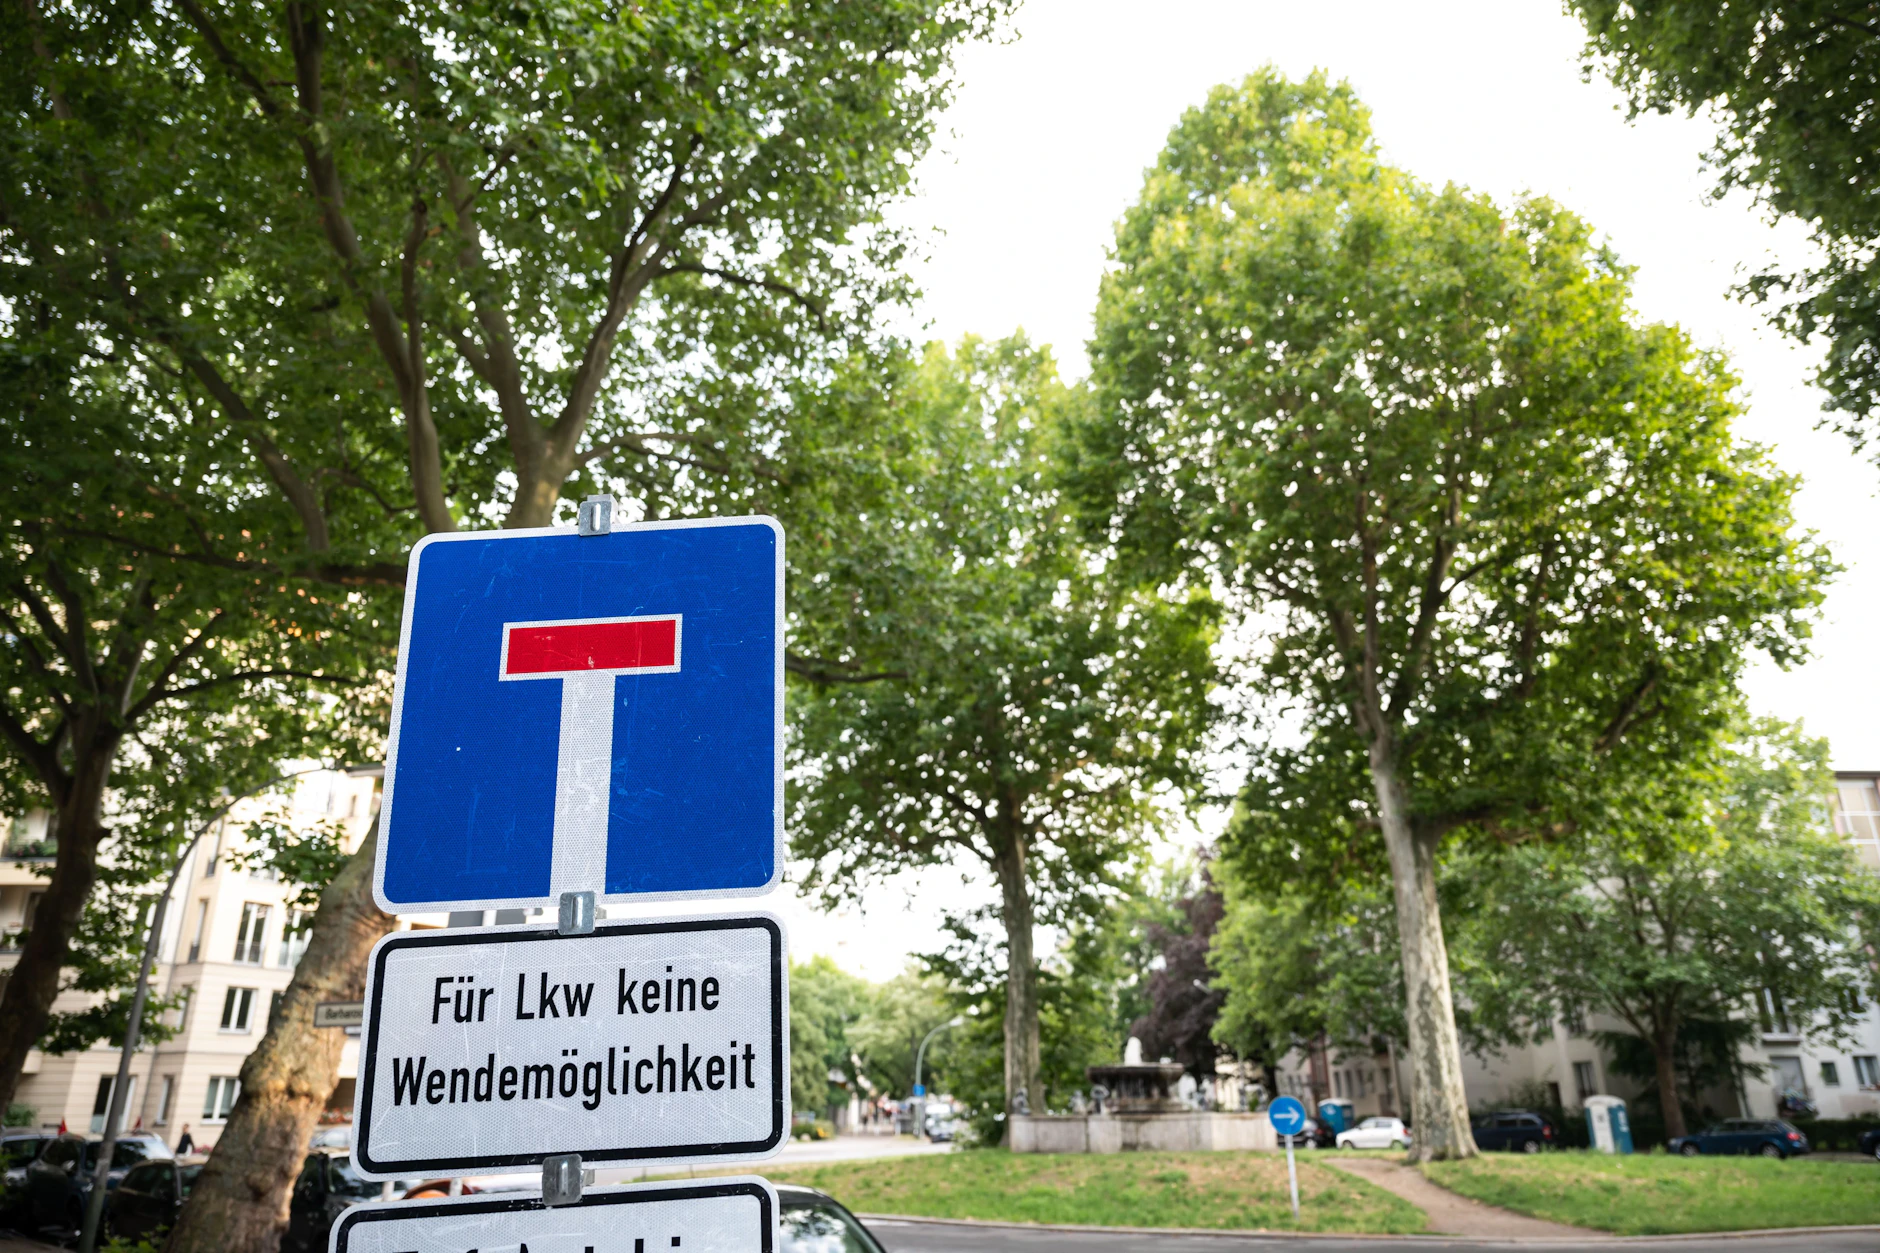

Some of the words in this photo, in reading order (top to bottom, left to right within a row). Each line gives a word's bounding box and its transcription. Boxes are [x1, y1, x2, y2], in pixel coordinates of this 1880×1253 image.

[432, 976, 495, 1025] Für
[516, 972, 595, 1020] Lkw
[617, 965, 721, 1016] keine
[393, 1040, 757, 1111] Wendemöglichkeit
